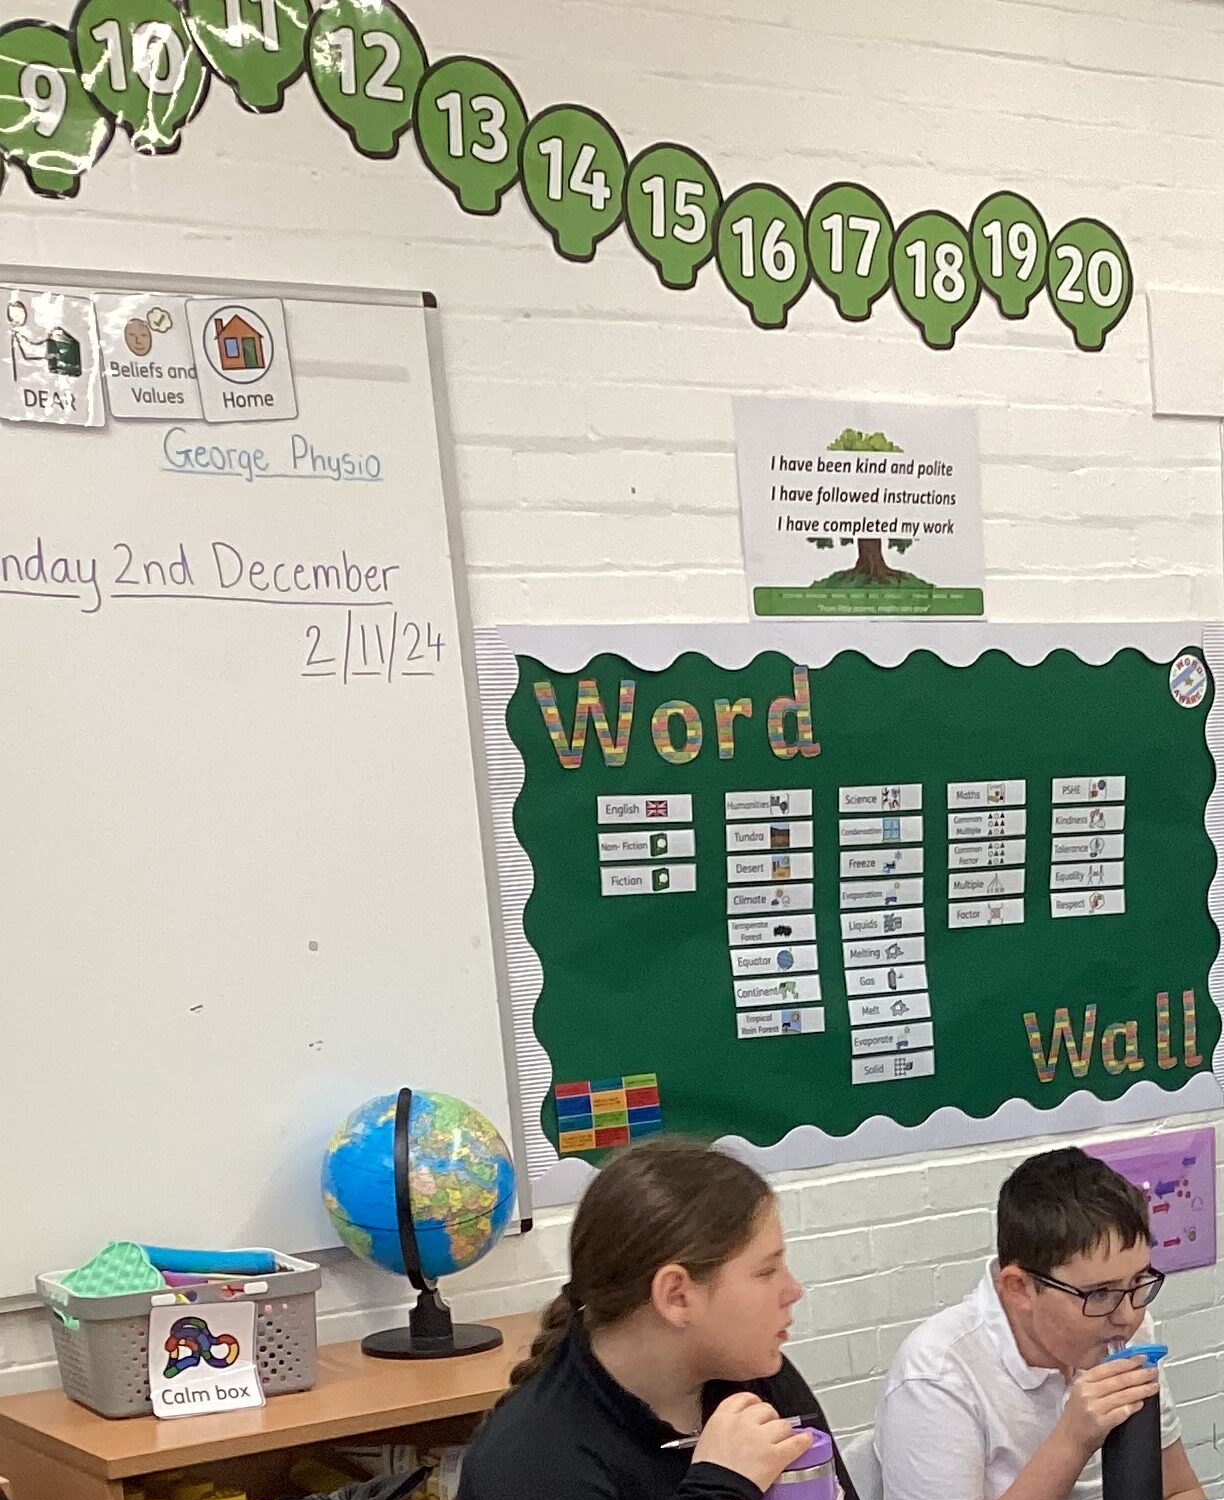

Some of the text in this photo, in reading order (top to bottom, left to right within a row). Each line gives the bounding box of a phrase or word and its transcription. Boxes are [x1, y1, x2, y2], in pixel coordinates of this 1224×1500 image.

[91, 20, 186, 94] 10
[325, 27, 404, 102] 12
[20, 63, 67, 137] 9
[436, 91, 509, 163] 13
[539, 138, 611, 210] 14
[641, 176, 707, 244] 15
[730, 216, 796, 283] 16
[821, 213, 880, 278] 17
[982, 219, 1037, 281] 19
[905, 238, 966, 304] 18
[1055, 244, 1124, 309] 20
[110, 361, 198, 380] Beliefs and
[131, 388, 184, 405] Values
[223, 392, 275, 409] Home
[163, 427, 381, 482] George Physio
[779, 456, 813, 472] have
[817, 457, 851, 473] been
[856, 457, 887, 474] kind
[890, 459, 914, 475] and
[917, 460, 953, 479] polite
[779, 486, 813, 502] have
[816, 487, 879, 505] followed
[883, 488, 956, 506] instructions
[786, 516, 819, 532] have
[823, 517, 897, 535] completed
[901, 520, 920, 537] my
[923, 519, 955, 534] work
[114, 542, 194, 587] 2nd
[212, 541, 400, 594] December
[533, 664, 822, 769] Word
[845, 794, 877, 804] Science
[956, 790, 980, 800] Maths
[605, 804, 640, 817] English
[734, 831, 764, 842] Tundra
[622, 841, 648, 851] Fiction
[736, 863, 764, 874] Desert
[848, 859, 876, 869] Freeze
[611, 875, 643, 886] Fiction
[953, 880, 984, 891] Multiple
[734, 895, 766, 905] Climate
[957, 910, 980, 920] Factor
[848, 919, 878, 932] Liquids
[850, 948, 881, 959] Melting
[737, 957, 771, 968] Equator
[860, 976, 875, 985] Gas
[737, 986, 779, 998] Continent
[862, 1005, 880, 1015] Melt
[854, 1036, 893, 1047] Evaporate
[1023, 987, 1203, 1083] Wall
[864, 1064, 884, 1075] Solid
[162, 1384, 251, 1406] Calm box
